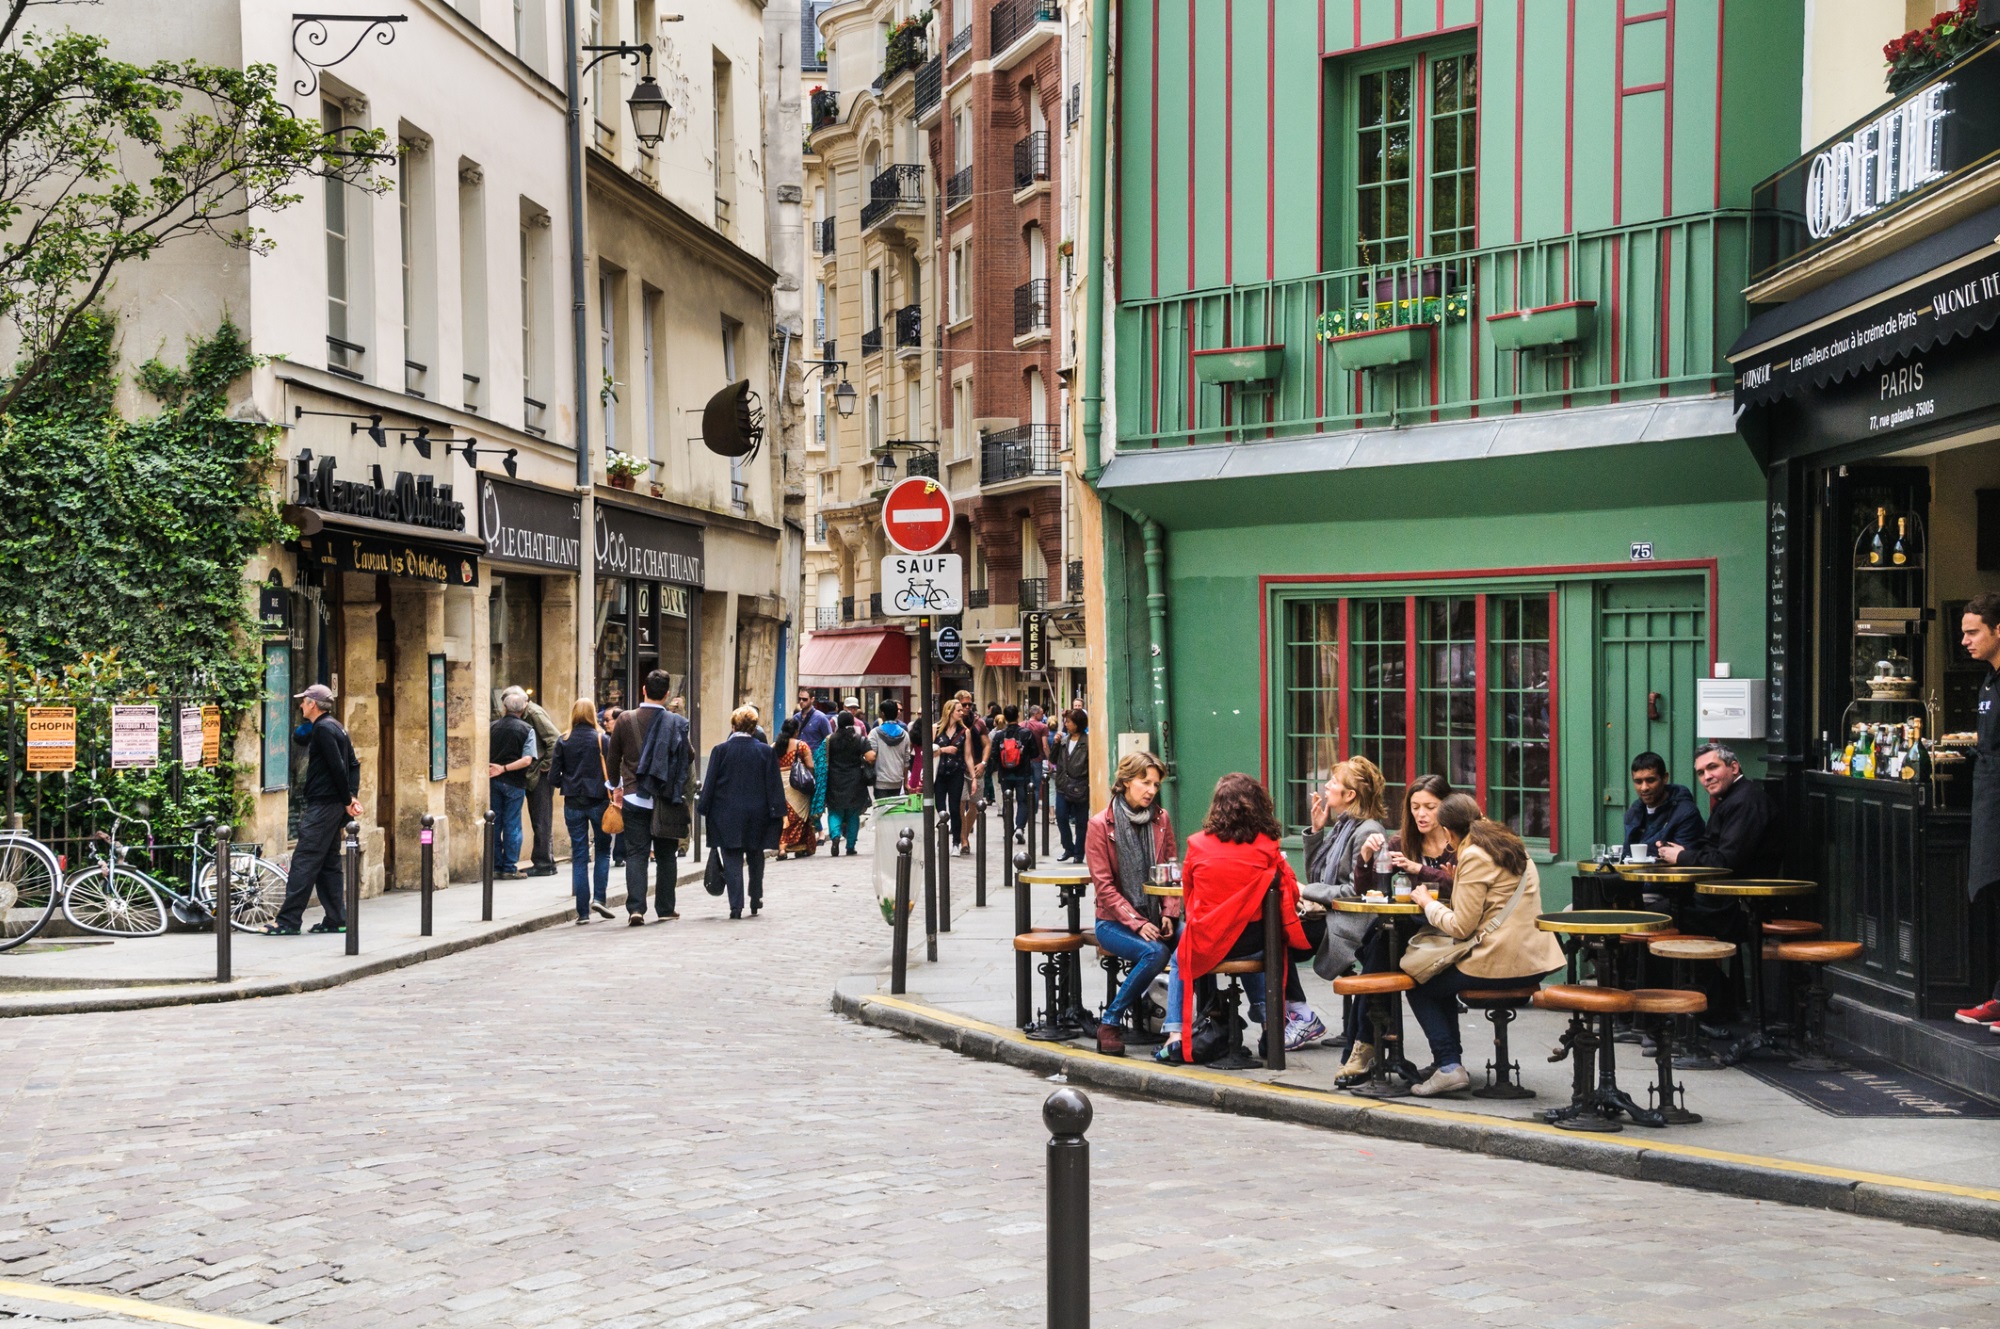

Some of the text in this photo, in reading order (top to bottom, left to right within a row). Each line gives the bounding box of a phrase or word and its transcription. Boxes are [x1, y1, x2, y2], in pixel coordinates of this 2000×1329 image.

[1806, 81, 1953, 239] ODETTE
[1790, 357, 1802, 373] Les
[1802, 346, 1829, 368] meilleurs
[1830, 339, 1850, 357] choux
[1857, 329, 1863, 347] la
[1885, 316, 1897, 335] de
[1898, 308, 1917, 331] Paris
[1933, 287, 1965, 320] SALON
[1965, 280, 1979, 307] DE
[1881, 362, 1923, 401] PARIS
[1879, 414, 1890, 428] rue
[1890, 405, 1914, 428] galande
[1915, 399, 1934, 417] 75005
[572, 502, 580, 520] 52
[502, 526, 579, 567] LE CHAT HUANT
[1632, 544, 1650, 558] 75
[629, 547, 643, 575] LE
[643, 549, 668, 578] CHAT
[670, 553, 699, 583] HUANT
[896, 559, 946, 574] SAUF
[30, 722, 74, 731] CHOPIN
